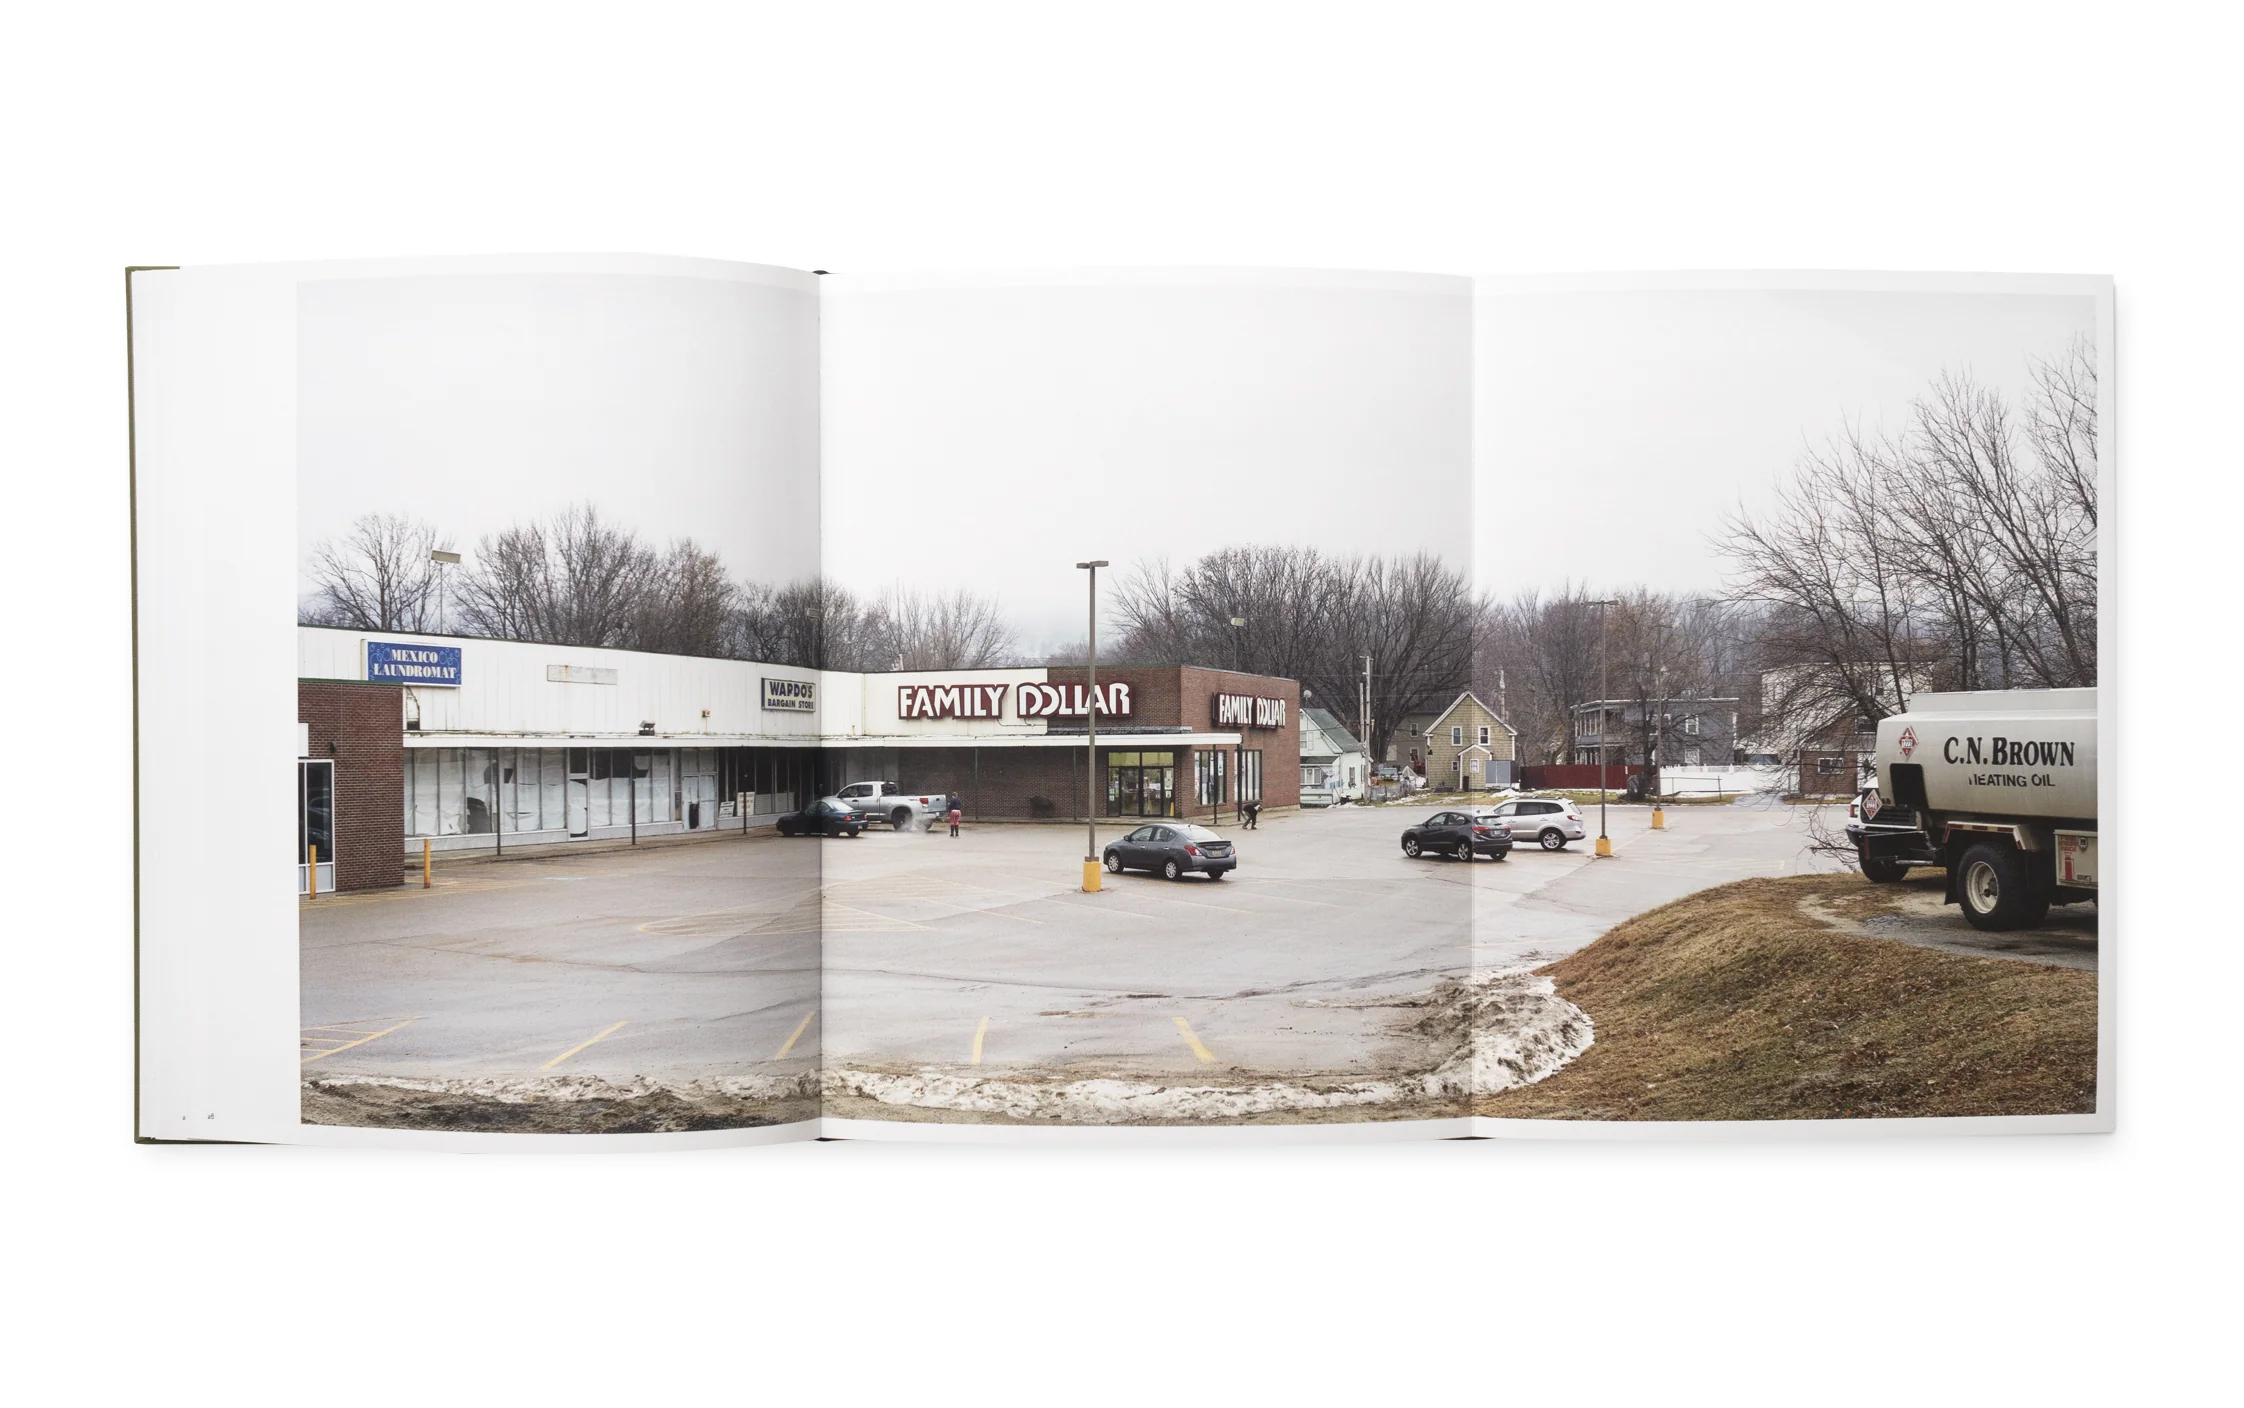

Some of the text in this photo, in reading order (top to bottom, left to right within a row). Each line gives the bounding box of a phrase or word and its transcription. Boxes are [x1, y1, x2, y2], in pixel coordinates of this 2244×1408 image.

[391, 649, 438, 664] MEXICO
[373, 663, 456, 679] LAUNDROMAT
[767, 698, 814, 709] BARGAIN STORE
[900, 682, 1131, 718] FAMILY DOLLAR
[1219, 694, 1286, 726] FAMILY DOLLAR
[2031, 773, 2056, 787] OIL
